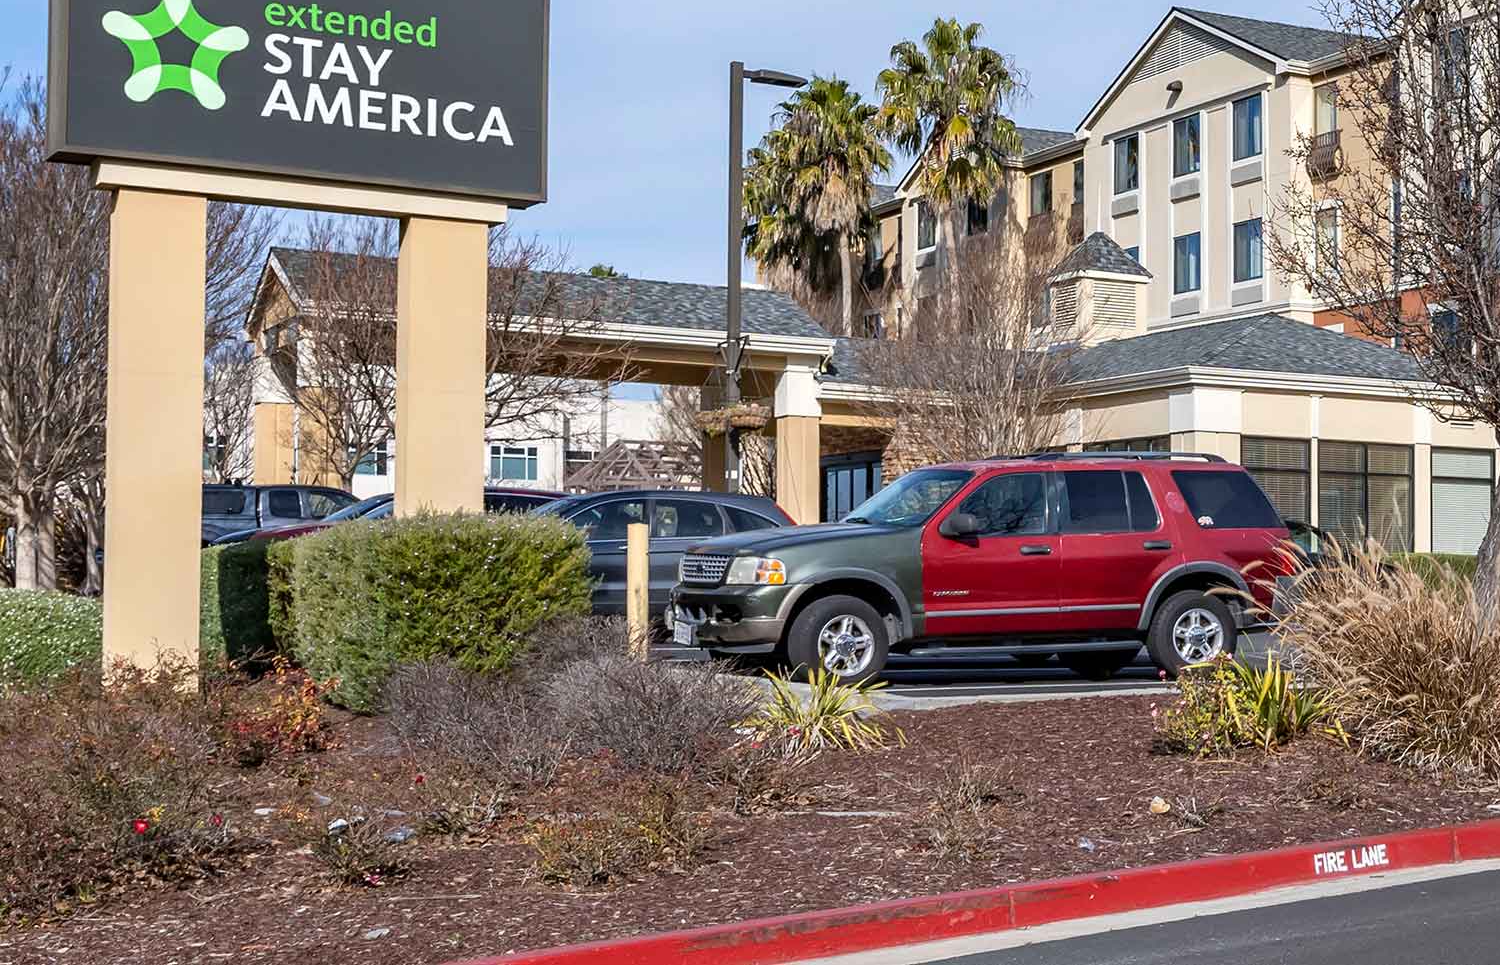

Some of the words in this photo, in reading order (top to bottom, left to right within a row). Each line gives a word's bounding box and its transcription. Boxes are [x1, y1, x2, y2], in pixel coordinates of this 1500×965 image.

[264, 2, 437, 47] extended
[263, 33, 393, 87] STAY
[260, 78, 514, 146] AMERICA
[1314, 850, 1348, 874] FIRE
[1351, 843, 1389, 868] LANE
